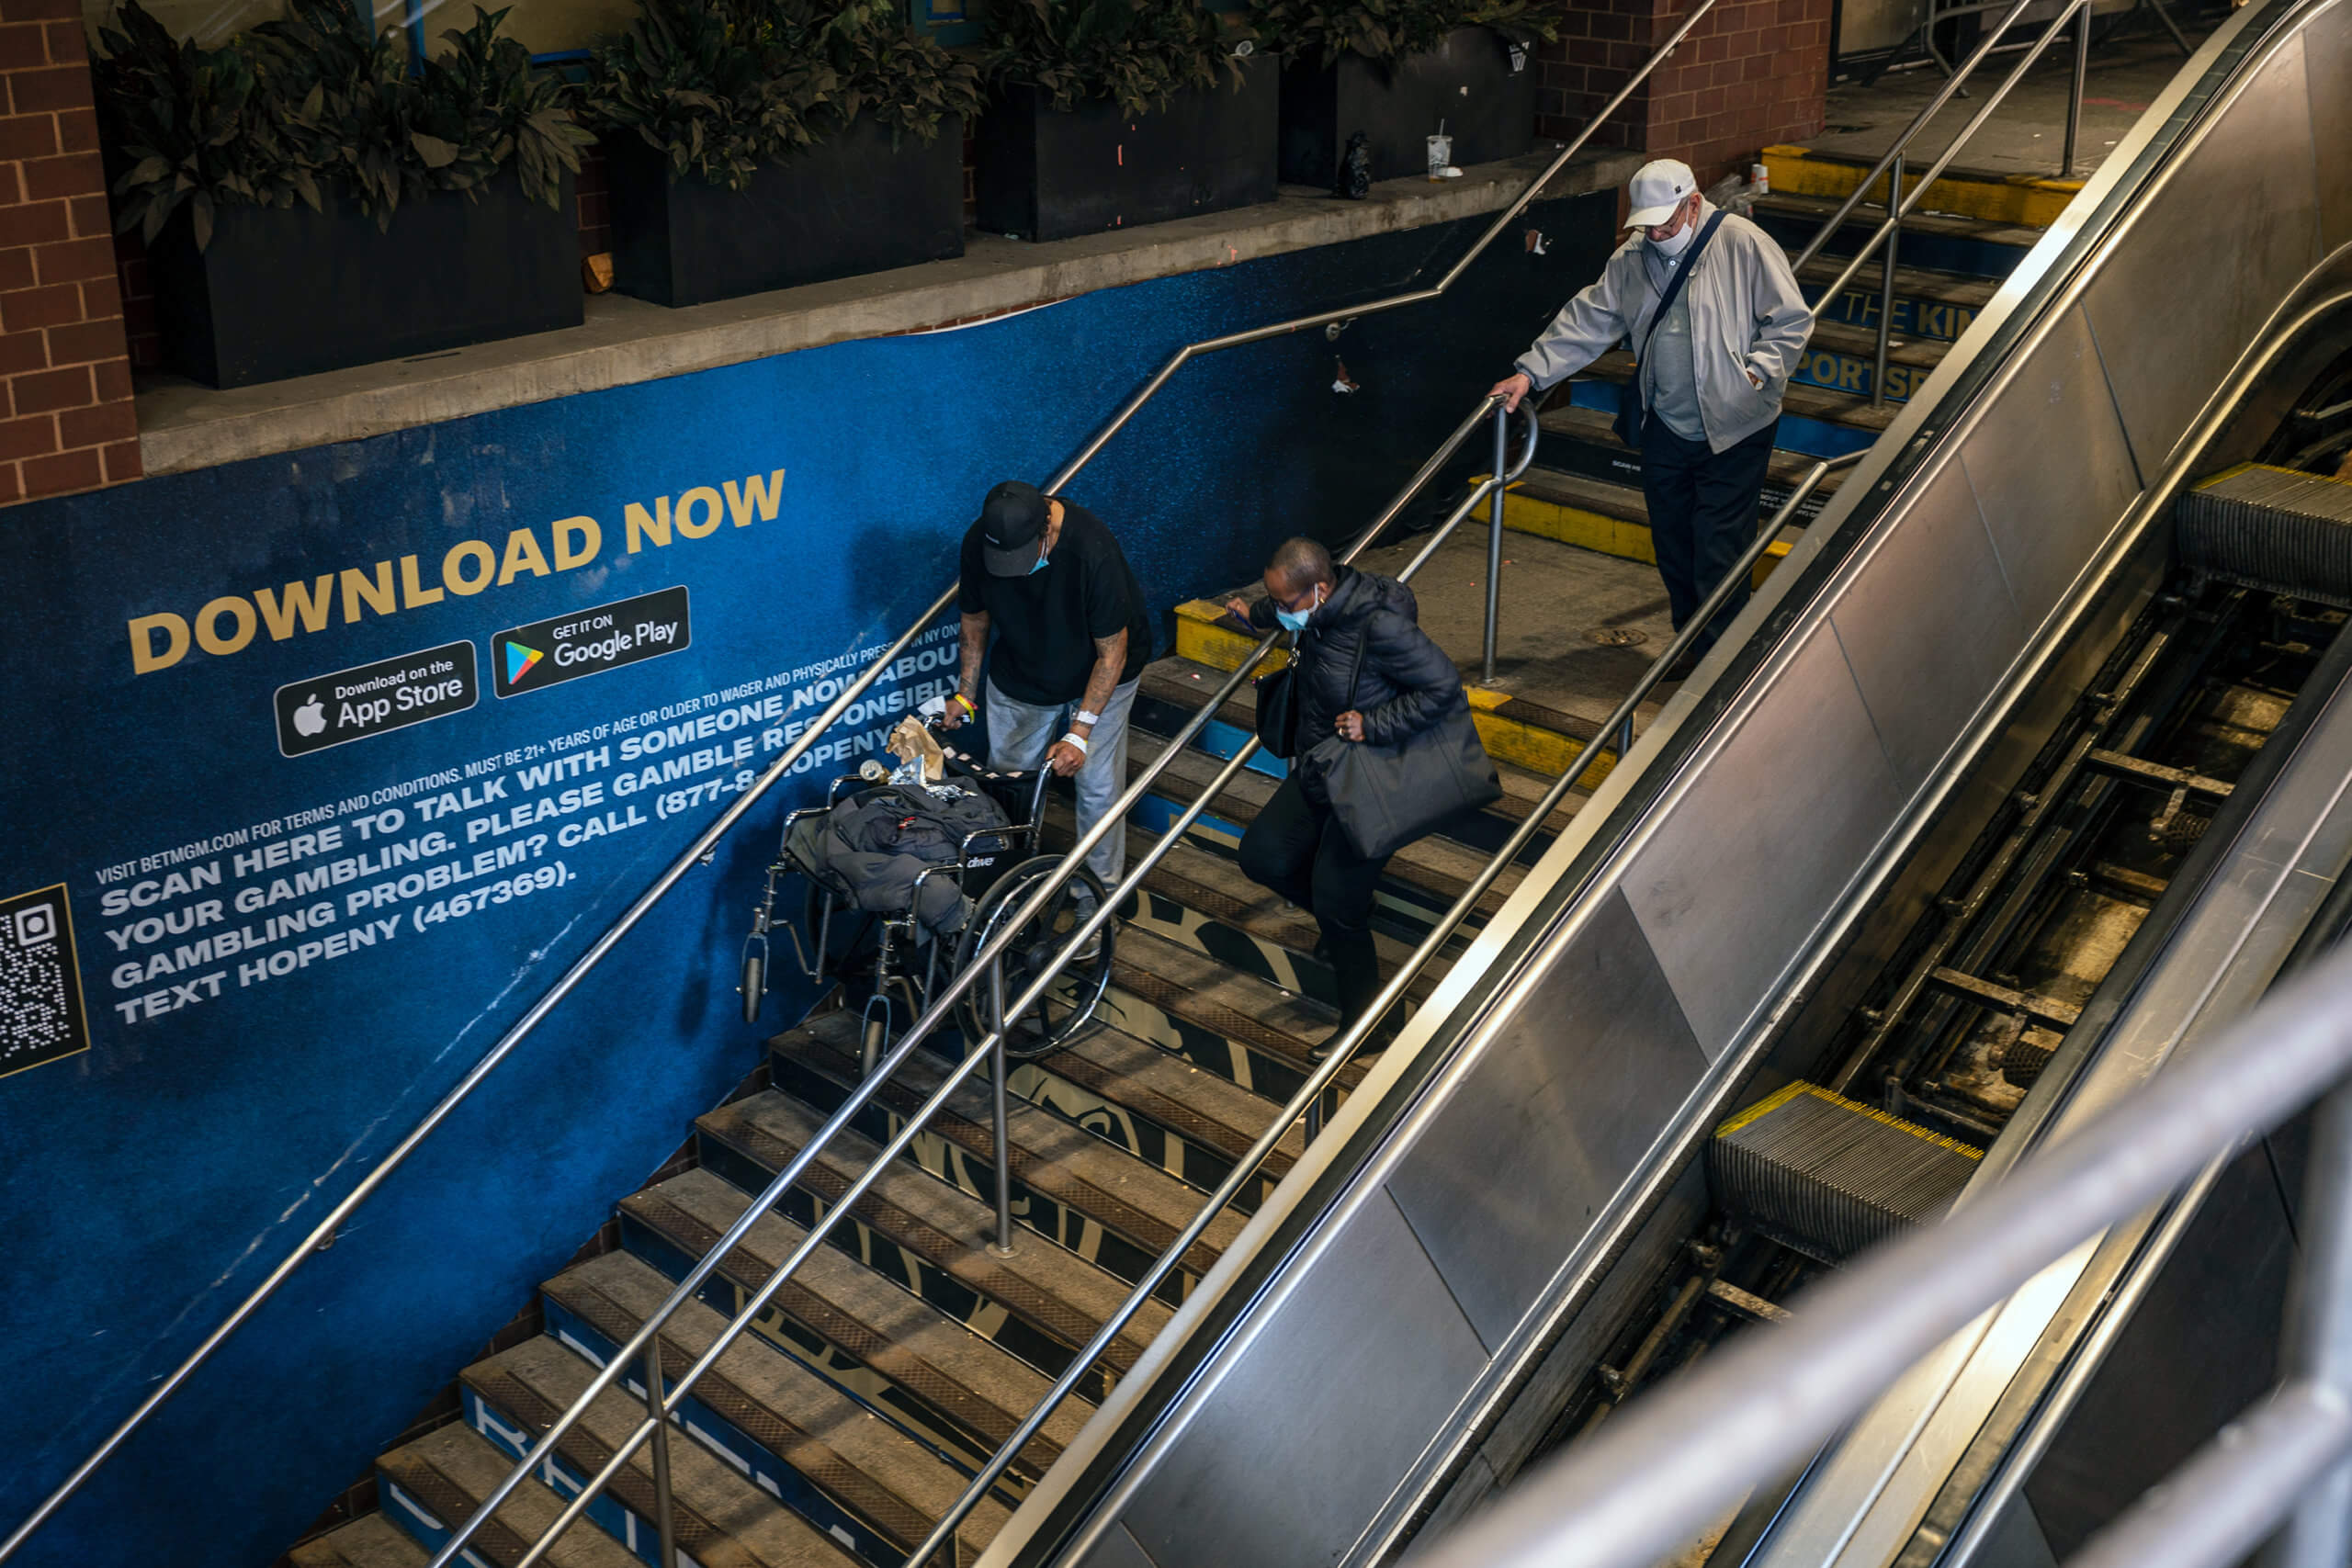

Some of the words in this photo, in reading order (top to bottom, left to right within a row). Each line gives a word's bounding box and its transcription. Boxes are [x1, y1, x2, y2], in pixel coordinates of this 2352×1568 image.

[1844, 291, 1909, 330] THE
[1917, 303, 1976, 339] KIN
[1792, 352, 1930, 399] PORTS
[128, 515, 602, 674] DOWNLOAD
[624, 468, 786, 553] NOW
[552, 623, 580, 640] GET
[581, 620, 593, 635] IT
[593, 614, 613, 631] ON
[554, 632, 632, 667] Google
[636, 621, 678, 647] Play
[334, 669, 406, 700] Download
[410, 665, 428, 681] on
[430, 658, 454, 674] the
[336, 694, 390, 728] App
[395, 678, 463, 711] Store
[96, 861, 138, 885] VISIT
[140, 829, 249, 873] BETMGM.COM
[252, 819, 282, 841] FOR
[283, 804, 335, 831] TERMS
[337, 794, 369, 816] AND
[371, 769, 462, 805] CONDITIONS.
[465, 754, 503, 779] MUST
[504, 749, 523, 766] BE
[524, 745, 547, 761] 21+
[548, 729, 591, 753] YEARS
[593, 724, 611, 740] OF
[612, 718, 638, 736] AGE
[639, 710, 659, 727] OR
[661, 697, 701, 721] OLDER
[702, 693, 718, 708] TO
[720, 680, 763, 703] WAGER
[764, 672, 791, 691] AND
[792, 652, 858, 682] PHYSICALLY
[860, 642, 895, 662] PRES
[924, 628, 940, 644] NY
[942, 623, 961, 639] ON
[100, 862, 222, 917] SCAN
[233, 825, 344, 878] HERE
[352, 808, 405, 841] TO
[413, 775, 508, 821] TALK
[516, 746, 611, 791] WITH
[620, 694, 784, 761] SOMEONE
[875, 642, 960, 687] ABOU
[105, 898, 225, 952] YOUR
[234, 831, 456, 913] GAMBLING.
[467, 781, 604, 843] PLEASE
[612, 736, 754, 797] GAMBLE
[110, 903, 336, 989] GAMBLING
[346, 833, 549, 915] PROBLEM?
[557, 799, 648, 848] CALL
[656, 721, 900, 820] (877-8-OPENY
[967, 856, 996, 869] drive
[115, 971, 228, 1024] TEXT
[238, 914, 402, 987] HOPENY
[412, 860, 577, 933] (467369).
